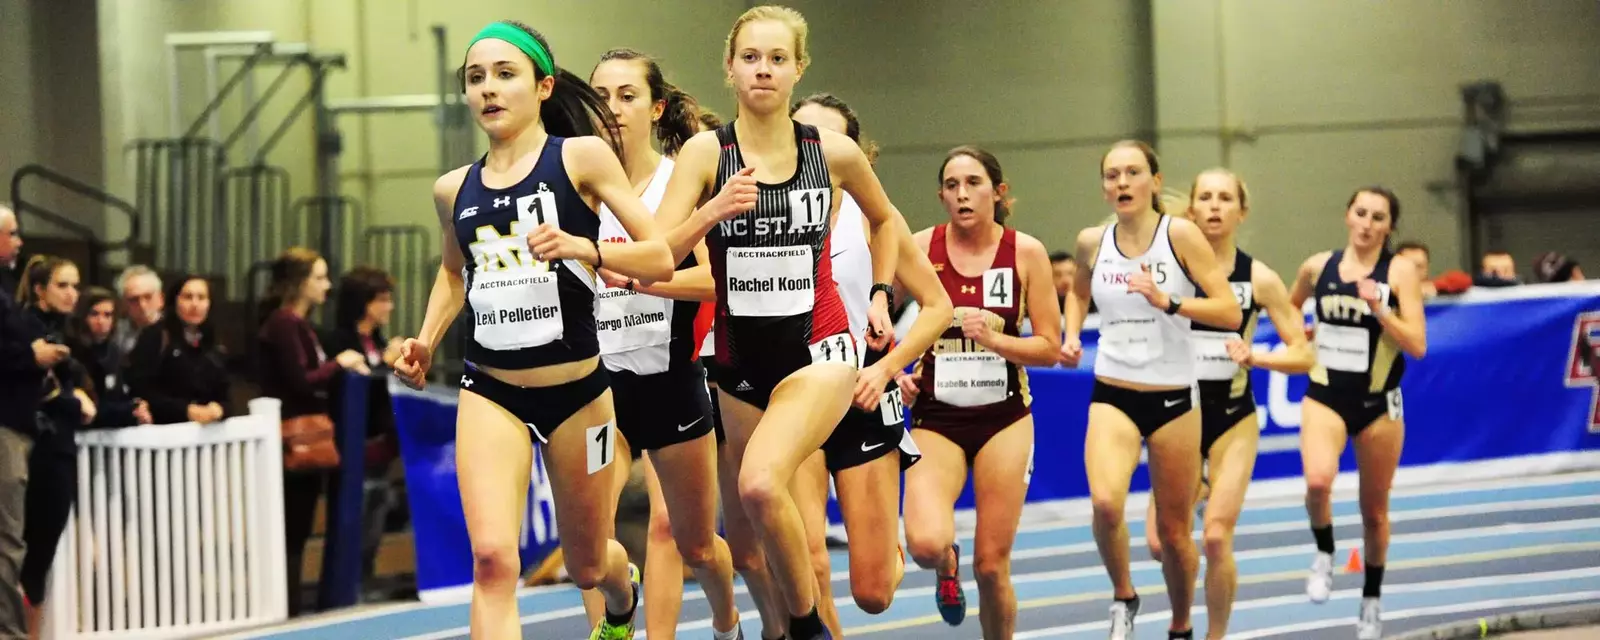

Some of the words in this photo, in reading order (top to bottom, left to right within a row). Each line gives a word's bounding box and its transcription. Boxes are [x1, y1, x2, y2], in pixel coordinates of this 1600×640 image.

[527, 197, 546, 226] 1
[800, 190, 824, 224] 11
[719, 219, 747, 237] NC
[729, 277, 774, 292] Rachel
[779, 277, 811, 292] Koon
[989, 272, 1008, 305] 4
[477, 310, 497, 326] Lexi
[499, 304, 559, 324] Pelletier
[624, 311, 665, 327] Malone
[1320, 294, 1364, 324] PITT
[819, 336, 848, 362] 11
[937, 380, 968, 388] Isabelle
[970, 379, 1006, 388] Kennedy
[887, 390, 904, 421] 16
[595, 425, 609, 466] 1
